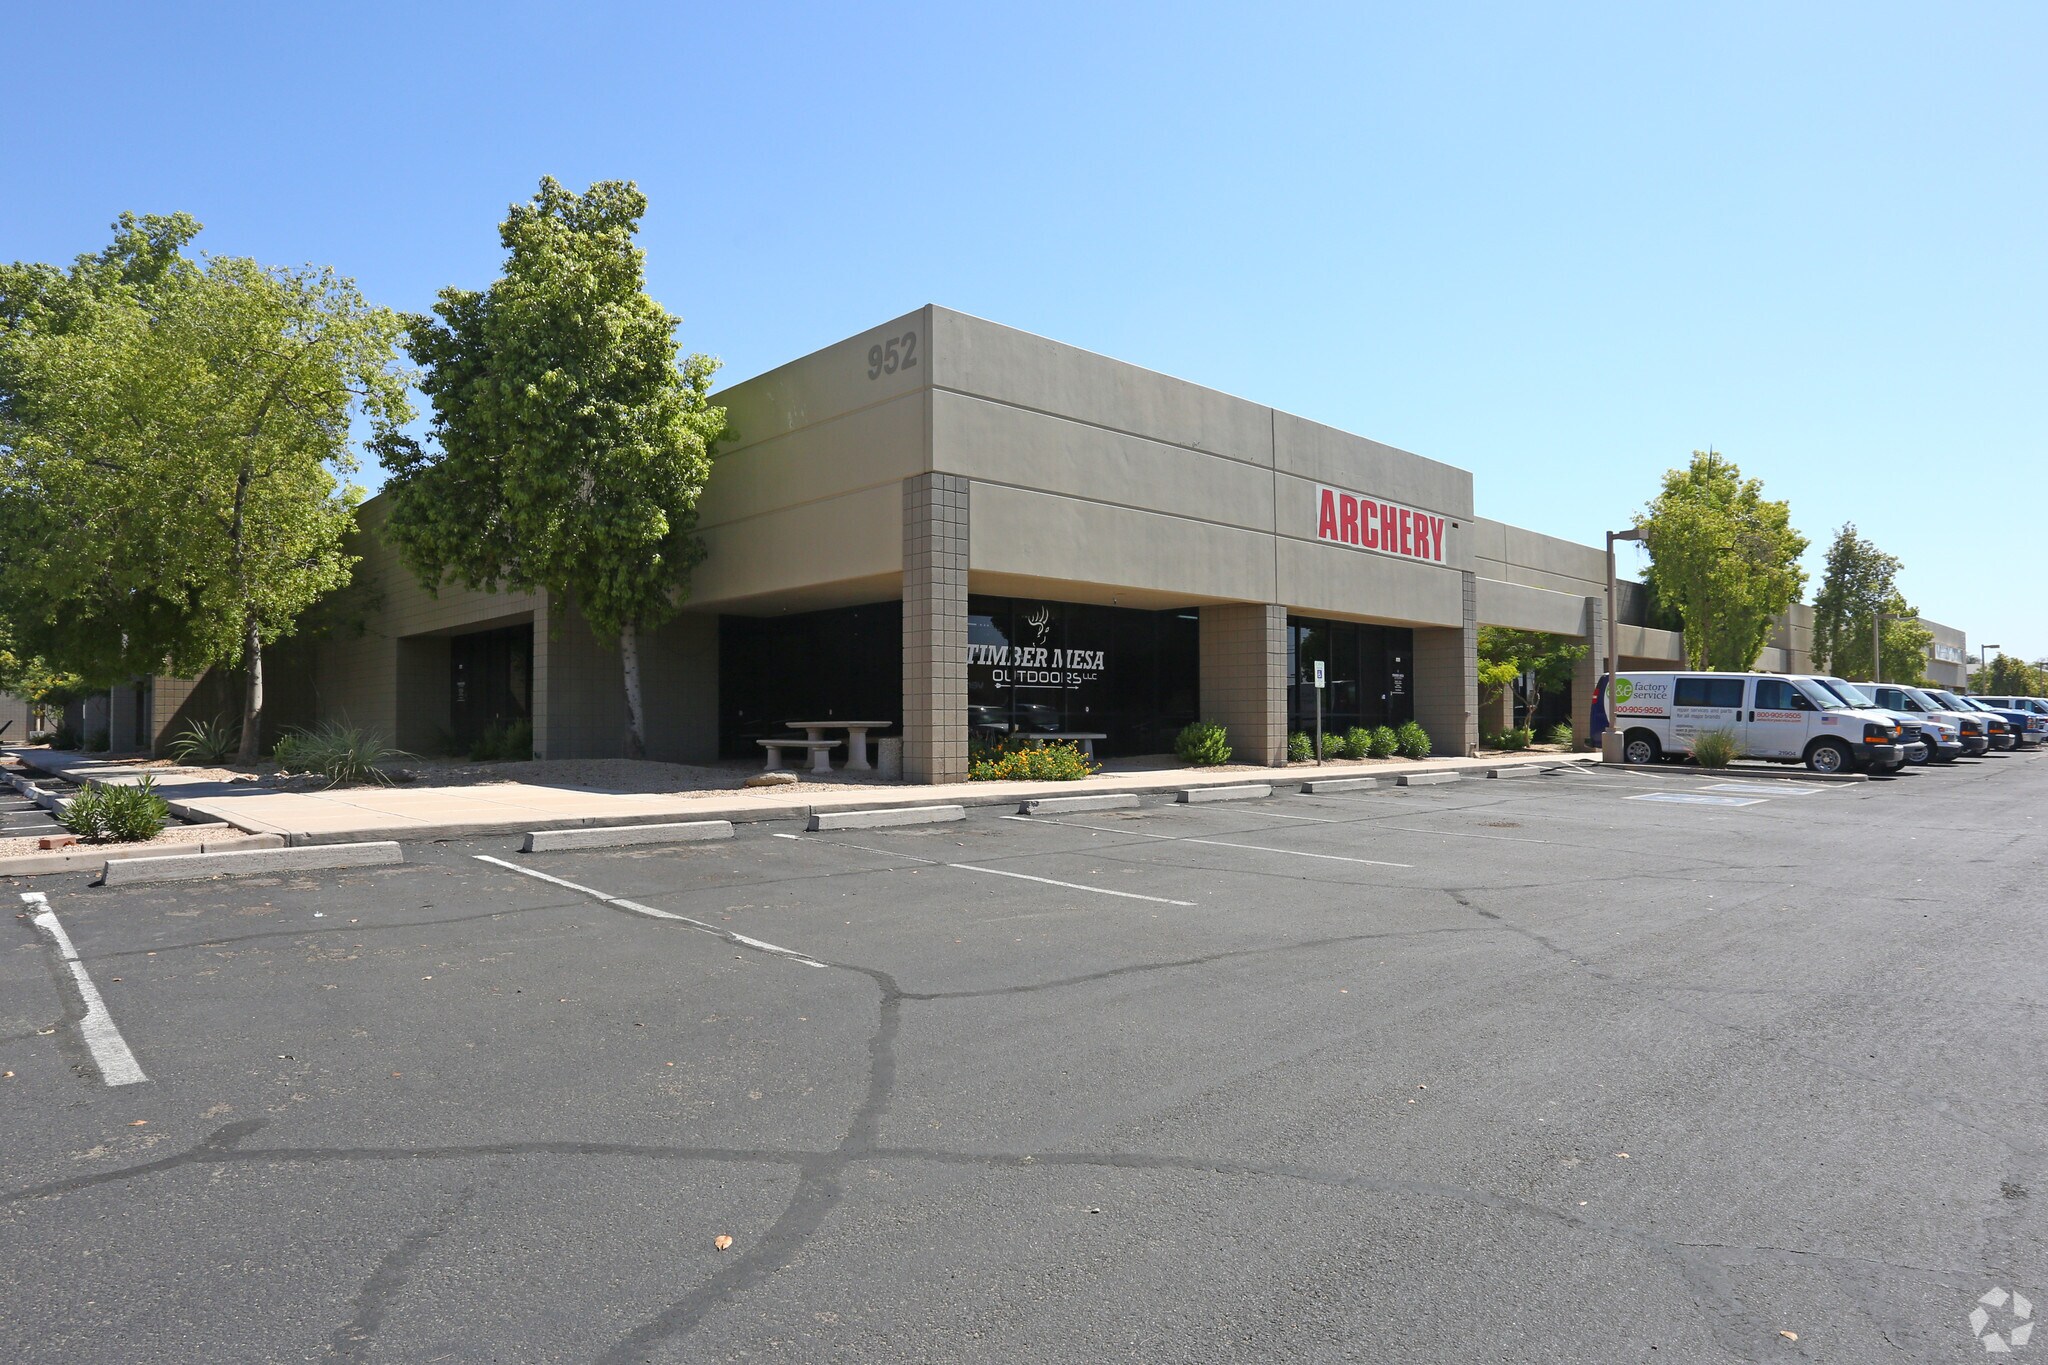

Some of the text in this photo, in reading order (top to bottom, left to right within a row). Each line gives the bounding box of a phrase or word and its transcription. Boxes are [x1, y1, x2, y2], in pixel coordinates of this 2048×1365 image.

[867, 331, 918, 381] 952
[1318, 488, 1445, 562] ARCHERY
[967, 643, 1105, 670] TIMBER MESA
[992, 669, 1098, 684] OUTDOORS LLC
[1633, 691, 1668, 700] service
[1634, 681, 1668, 694] factory
